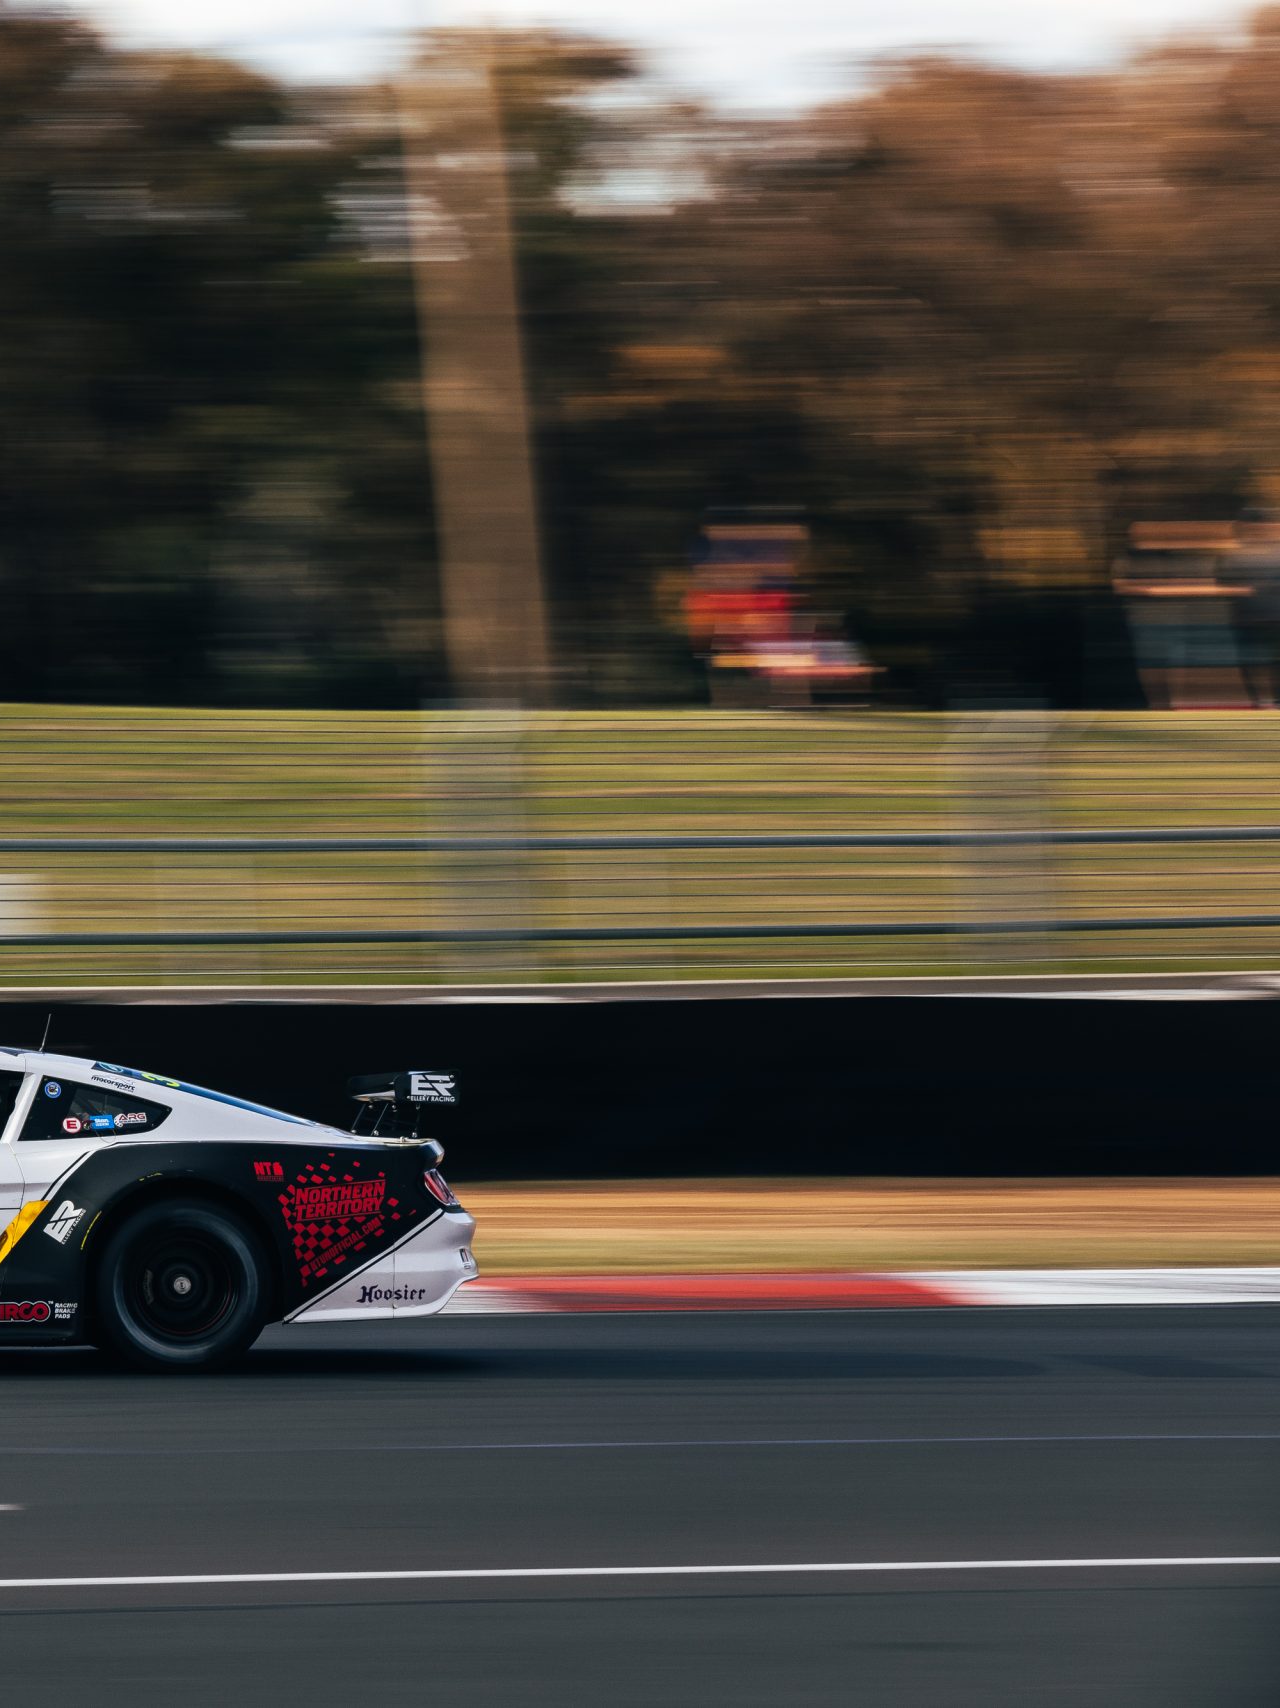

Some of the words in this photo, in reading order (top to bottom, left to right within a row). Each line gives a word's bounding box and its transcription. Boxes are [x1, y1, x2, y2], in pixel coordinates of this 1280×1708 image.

[66, 1119, 78, 1130] E
[118, 1113, 146, 1121] ARG
[253, 1161, 272, 1176] NT
[295, 1182, 386, 1204] NORTHERN
[294, 1197, 384, 1221] TERRITORY
[356, 1283, 426, 1303] Hoosier
